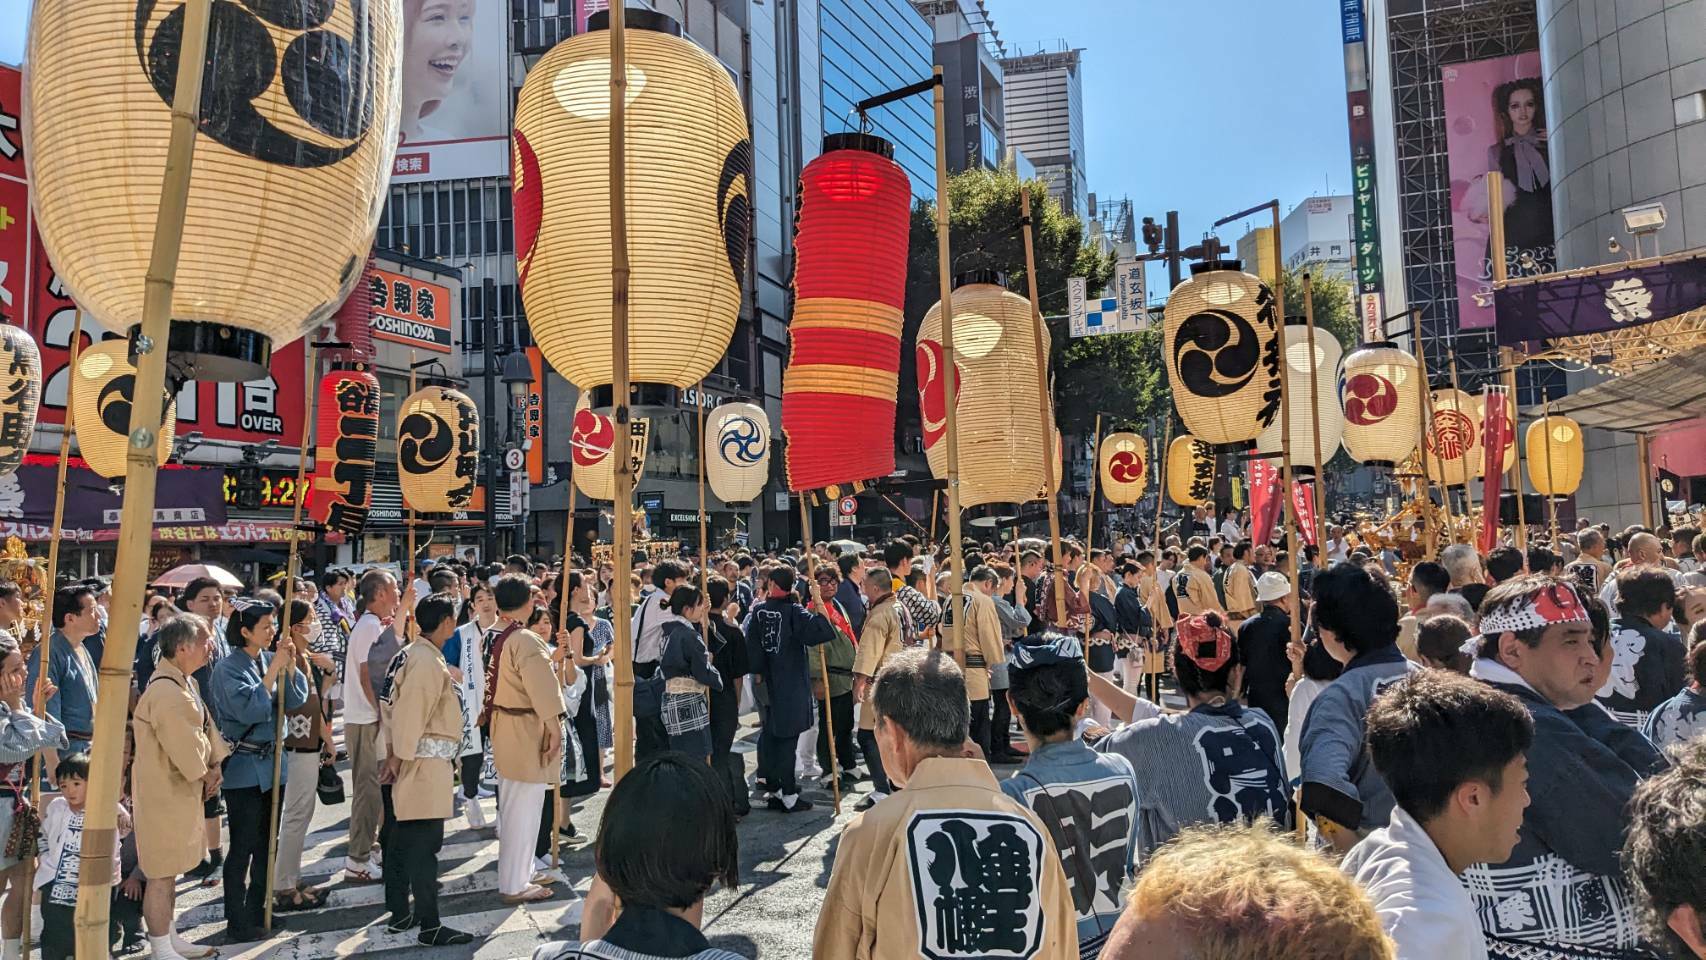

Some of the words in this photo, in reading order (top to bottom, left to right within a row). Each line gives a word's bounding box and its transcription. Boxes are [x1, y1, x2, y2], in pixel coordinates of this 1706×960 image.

[396, 157, 422, 172] 検索
[1364, 283, 1375, 291] 3F
[369, 275, 434, 319] 吉野家
[1129, 267, 1143, 325] 道玄坂下
[241, 414, 282, 432] OVER
[529, 394, 540, 437] 吉野家
[510, 451, 519, 467] 3
[671, 513, 696, 522] EXCELSIOR
